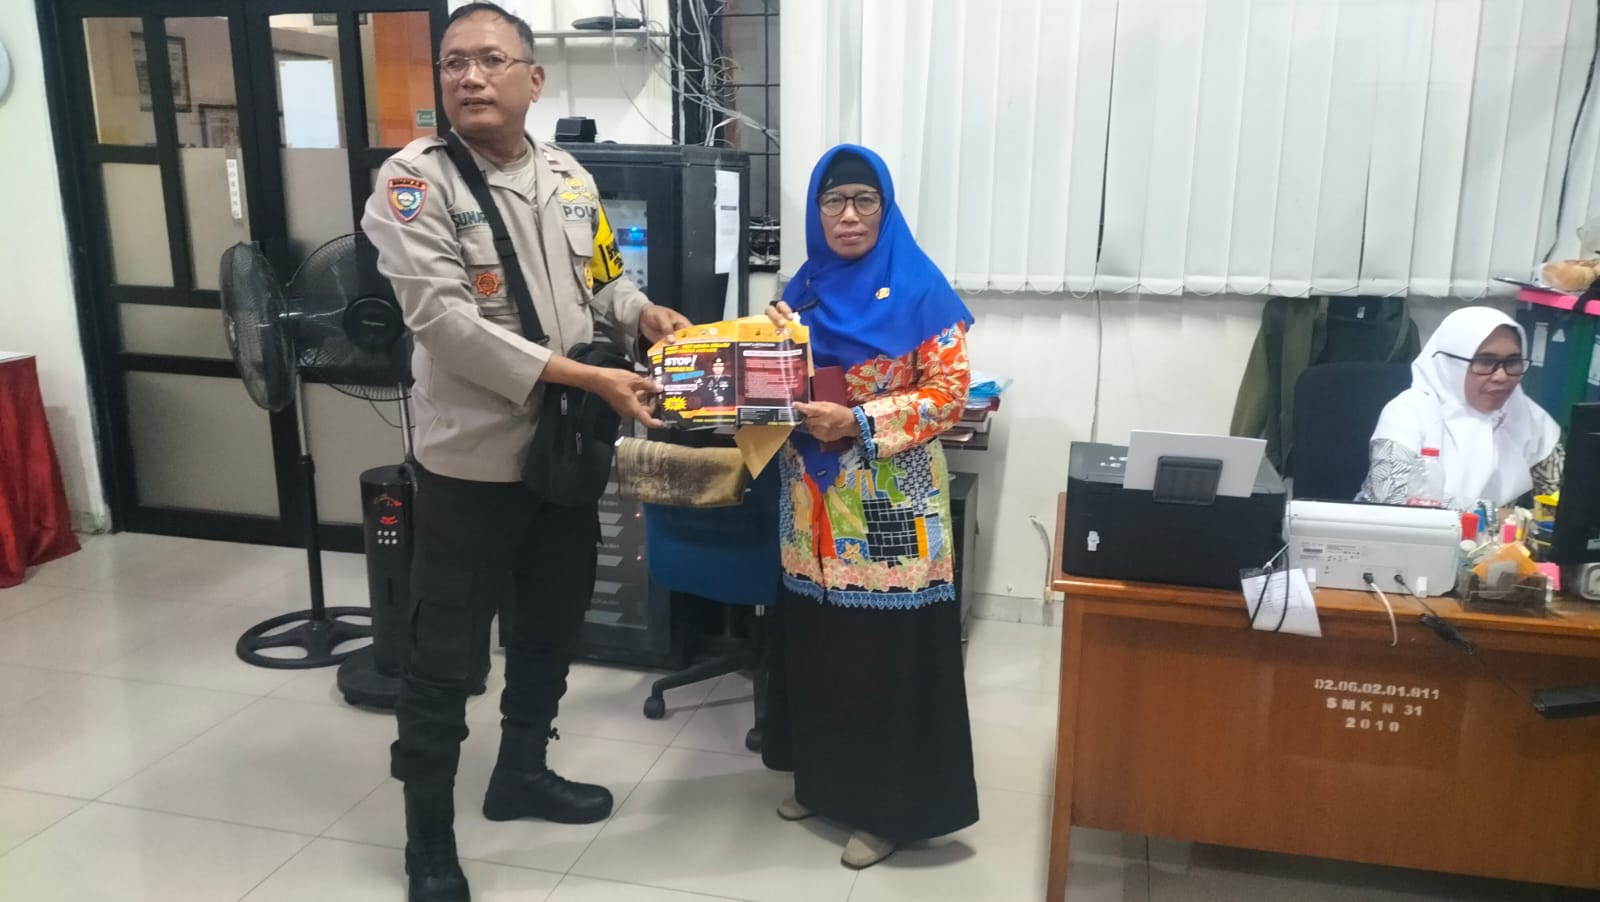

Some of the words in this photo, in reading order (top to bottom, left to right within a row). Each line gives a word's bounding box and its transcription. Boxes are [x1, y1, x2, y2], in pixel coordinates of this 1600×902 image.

[664, 354, 698, 366] STOP!
[1314, 679, 1440, 700] 02.06.02.01.011
[1403, 704, 1422, 716] 31
[1345, 717, 1400, 732] 2010
